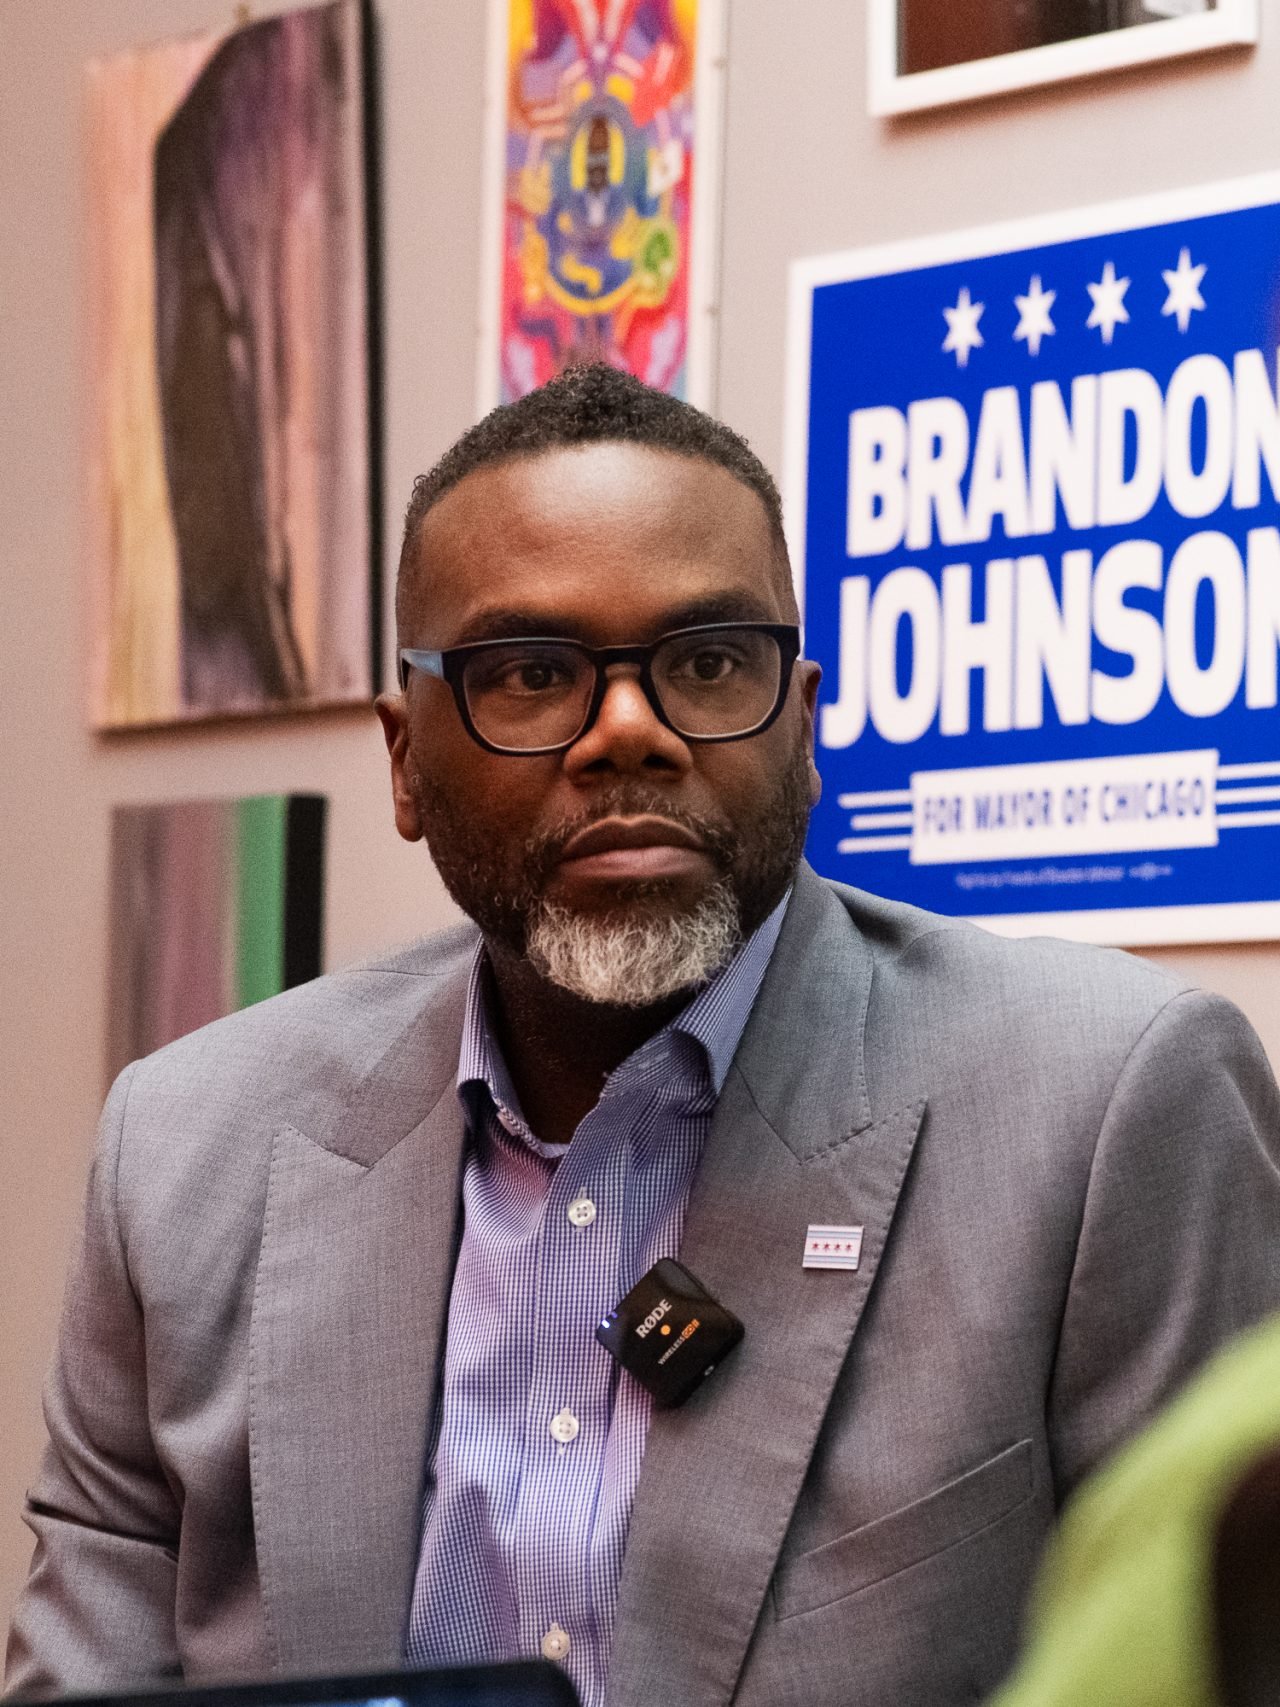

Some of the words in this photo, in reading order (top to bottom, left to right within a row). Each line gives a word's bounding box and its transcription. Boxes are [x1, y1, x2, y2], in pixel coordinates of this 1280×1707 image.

[922, 795, 962, 833] FOR
[974, 788, 1052, 829] MAYOR
[1062, 784, 1089, 823] OF
[1099, 778, 1206, 821] CHICAGO
